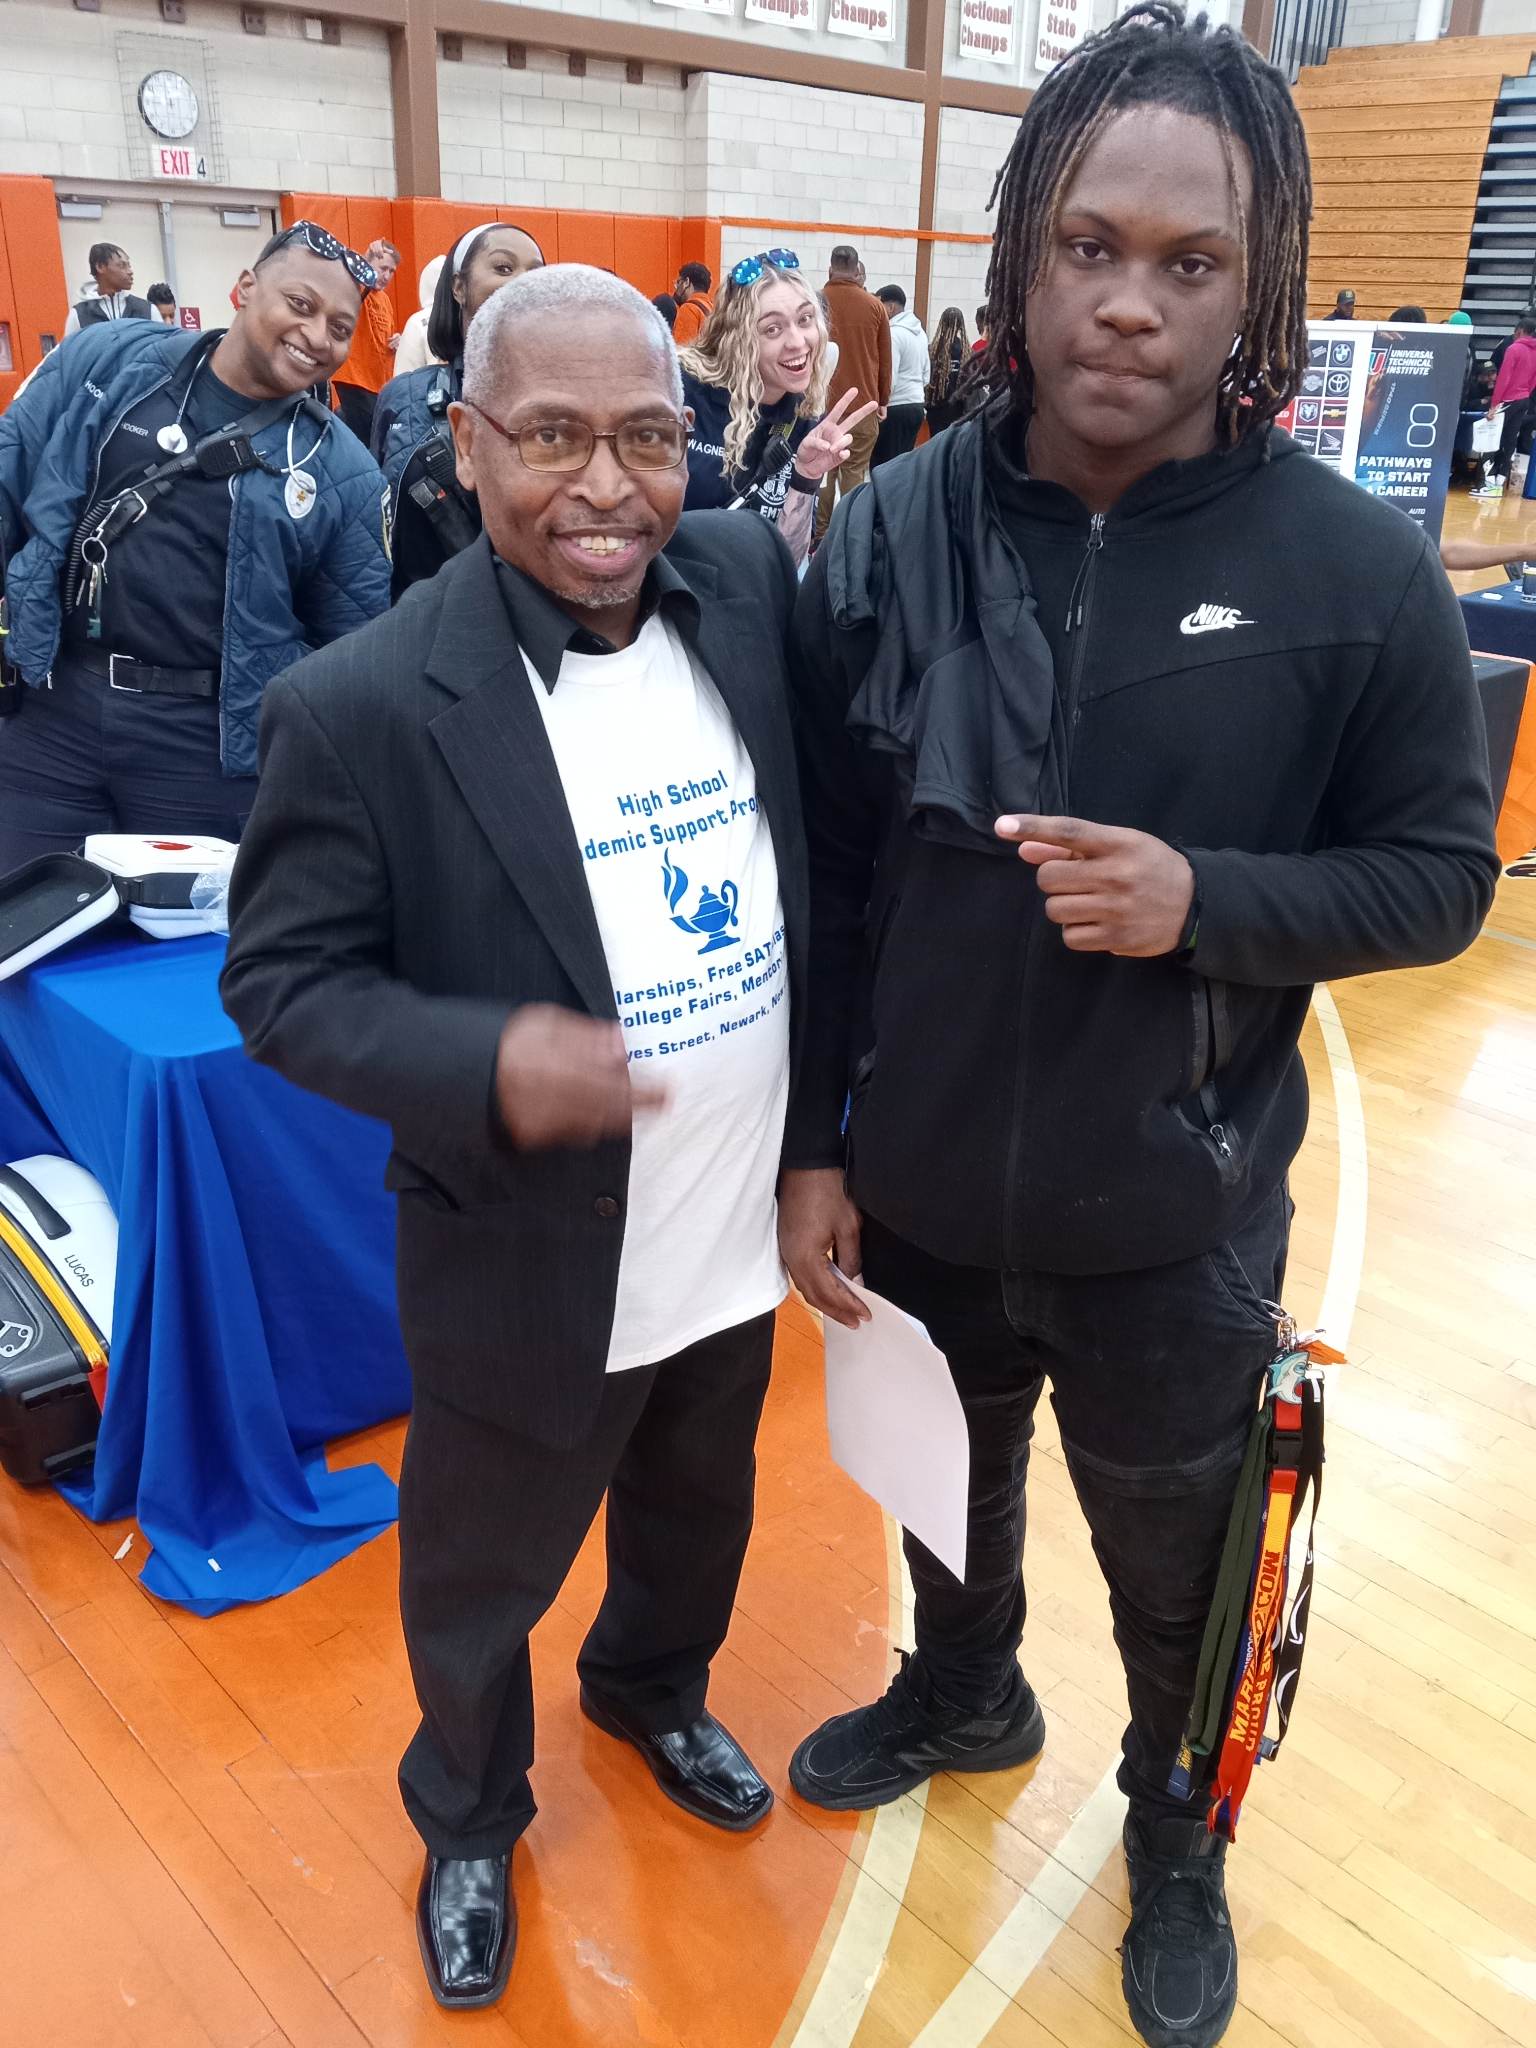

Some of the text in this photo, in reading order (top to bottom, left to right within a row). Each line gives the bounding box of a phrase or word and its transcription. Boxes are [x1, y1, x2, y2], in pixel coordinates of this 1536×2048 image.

[751, 0, 809, 19] amps
[831, 0, 888, 30] Champs
[963, 0, 1013, 25] ectional
[961, 23, 1008, 55] Champs
[1046, 12, 1077, 39] State
[160, 149, 207, 178] EXIT 4
[1388, 358, 1432, 368] TECHNICAL
[1390, 349, 1435, 359] UNIVERSAL
[1386, 366, 1430, 376] INSTITUTE
[1406, 403, 1439, 448] 8
[1360, 455, 1433, 469] PATHWAYS
[1367, 470, 1432, 483] TO START
[1376, 486, 1429, 498] CAREER
[1191, 602, 1242, 630] NIKE
[616, 769, 729, 817] High School
[584, 829, 647, 860] demic
[649, 808, 729, 845] Support
[615, 978, 704, 1006] larships,
[707, 961, 743, 983] Free
[744, 941, 772, 968] SAT
[688, 989, 738, 1014] Fairs,
[658, 1031, 716, 1056] Street,
[719, 1005, 770, 1035] Newark,
[64, 1254, 94, 1288] LUCAS
